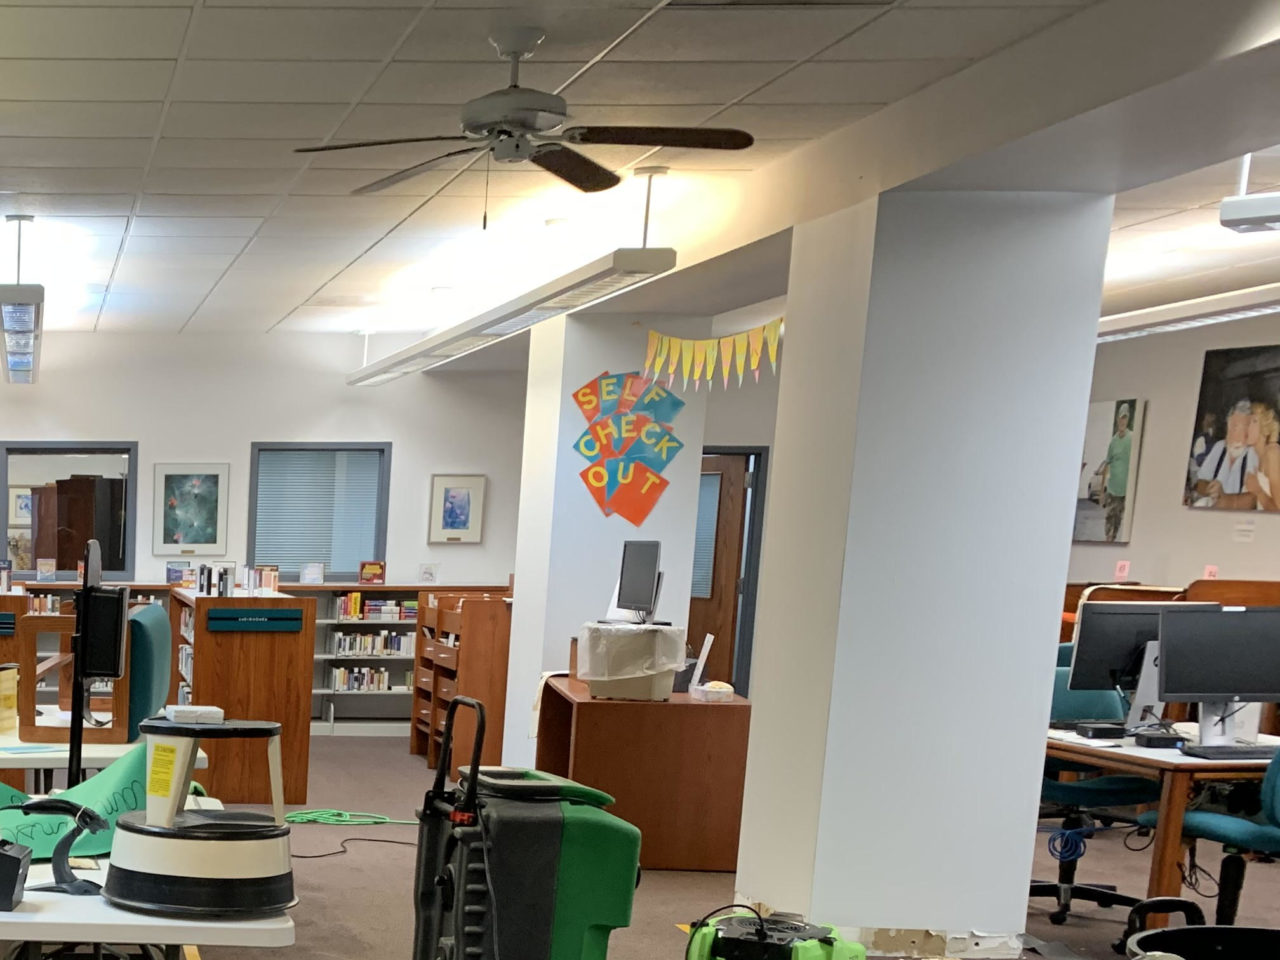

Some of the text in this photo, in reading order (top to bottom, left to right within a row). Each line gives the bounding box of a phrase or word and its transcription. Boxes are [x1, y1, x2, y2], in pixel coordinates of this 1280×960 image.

[577, 378, 668, 410] SELF
[579, 416, 680, 461] CHECK
[587, 461, 660, 495] OUT
